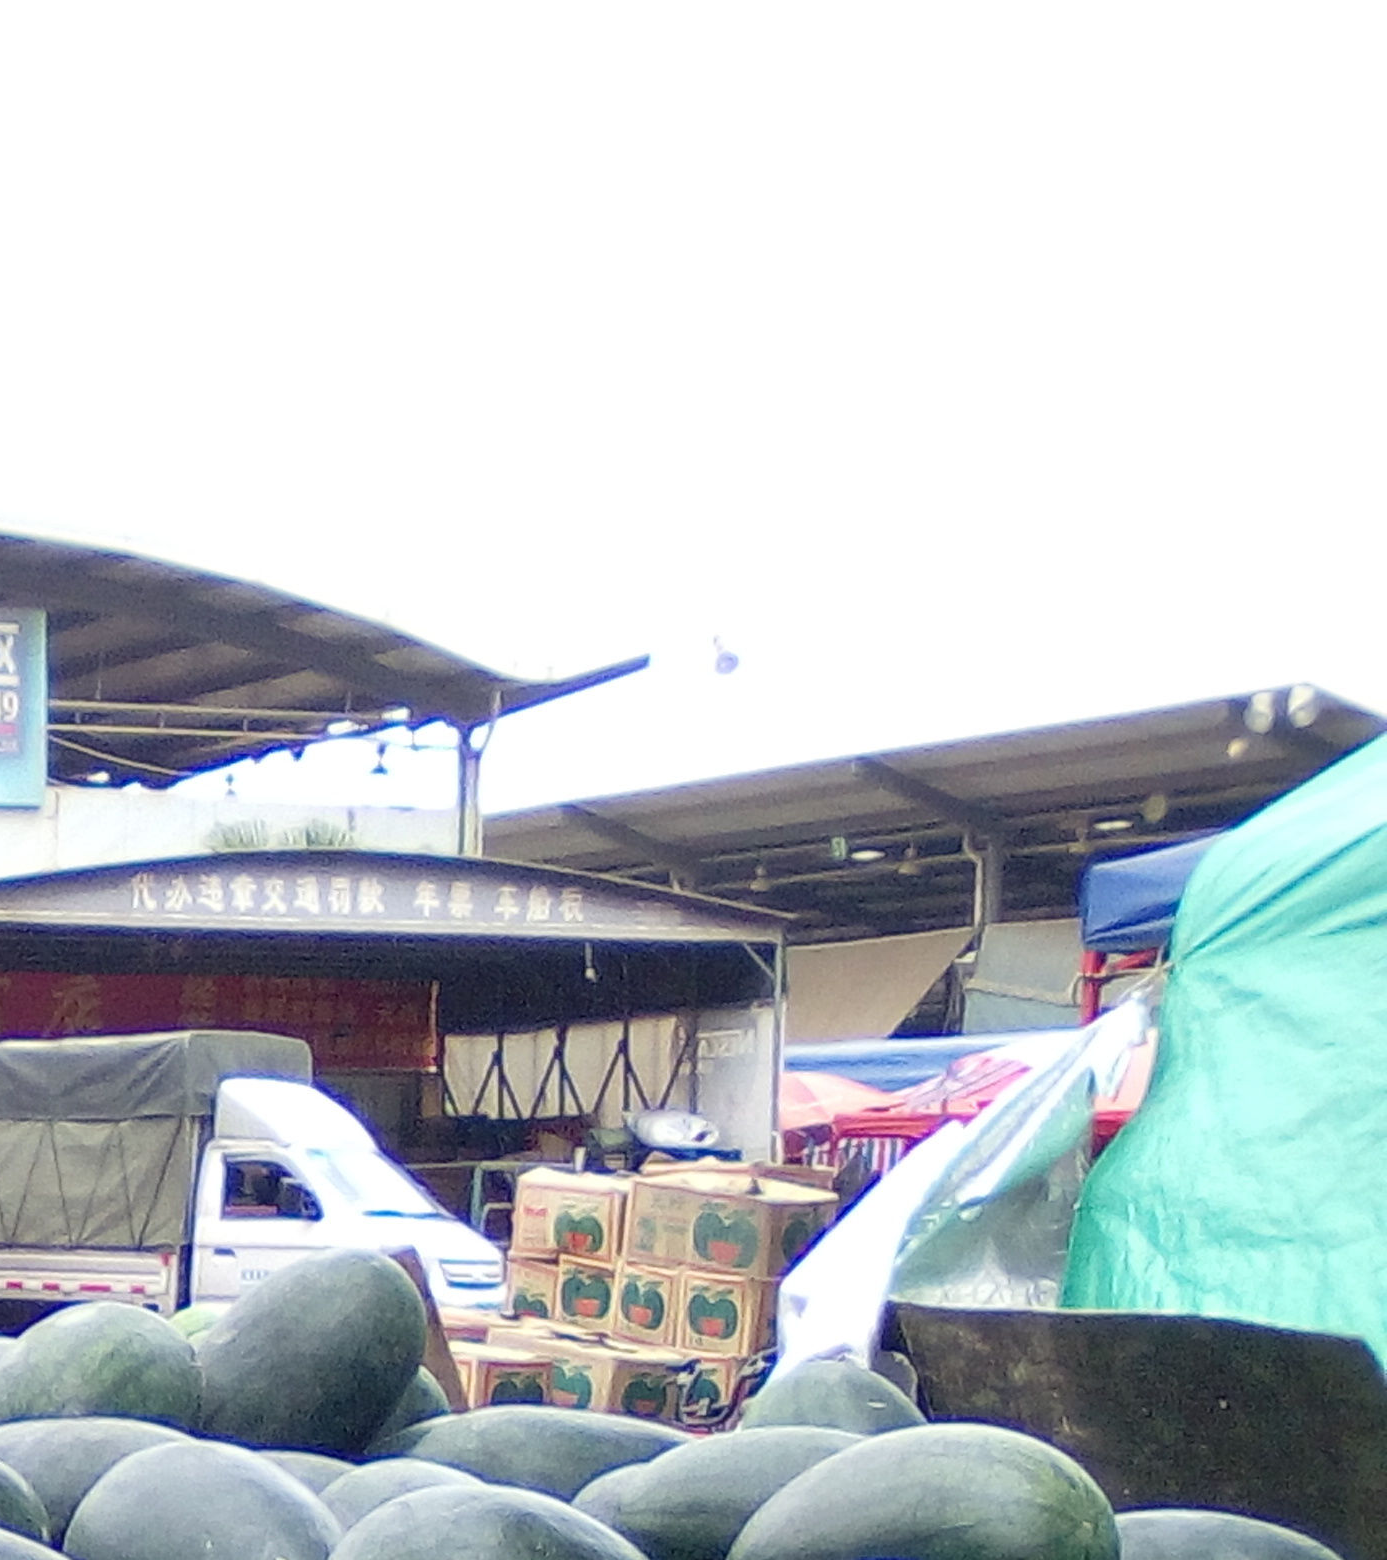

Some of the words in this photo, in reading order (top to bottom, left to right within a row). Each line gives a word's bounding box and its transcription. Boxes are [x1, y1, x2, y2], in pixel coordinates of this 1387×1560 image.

[131, 872, 386, 915] 代办违章交通罚款
